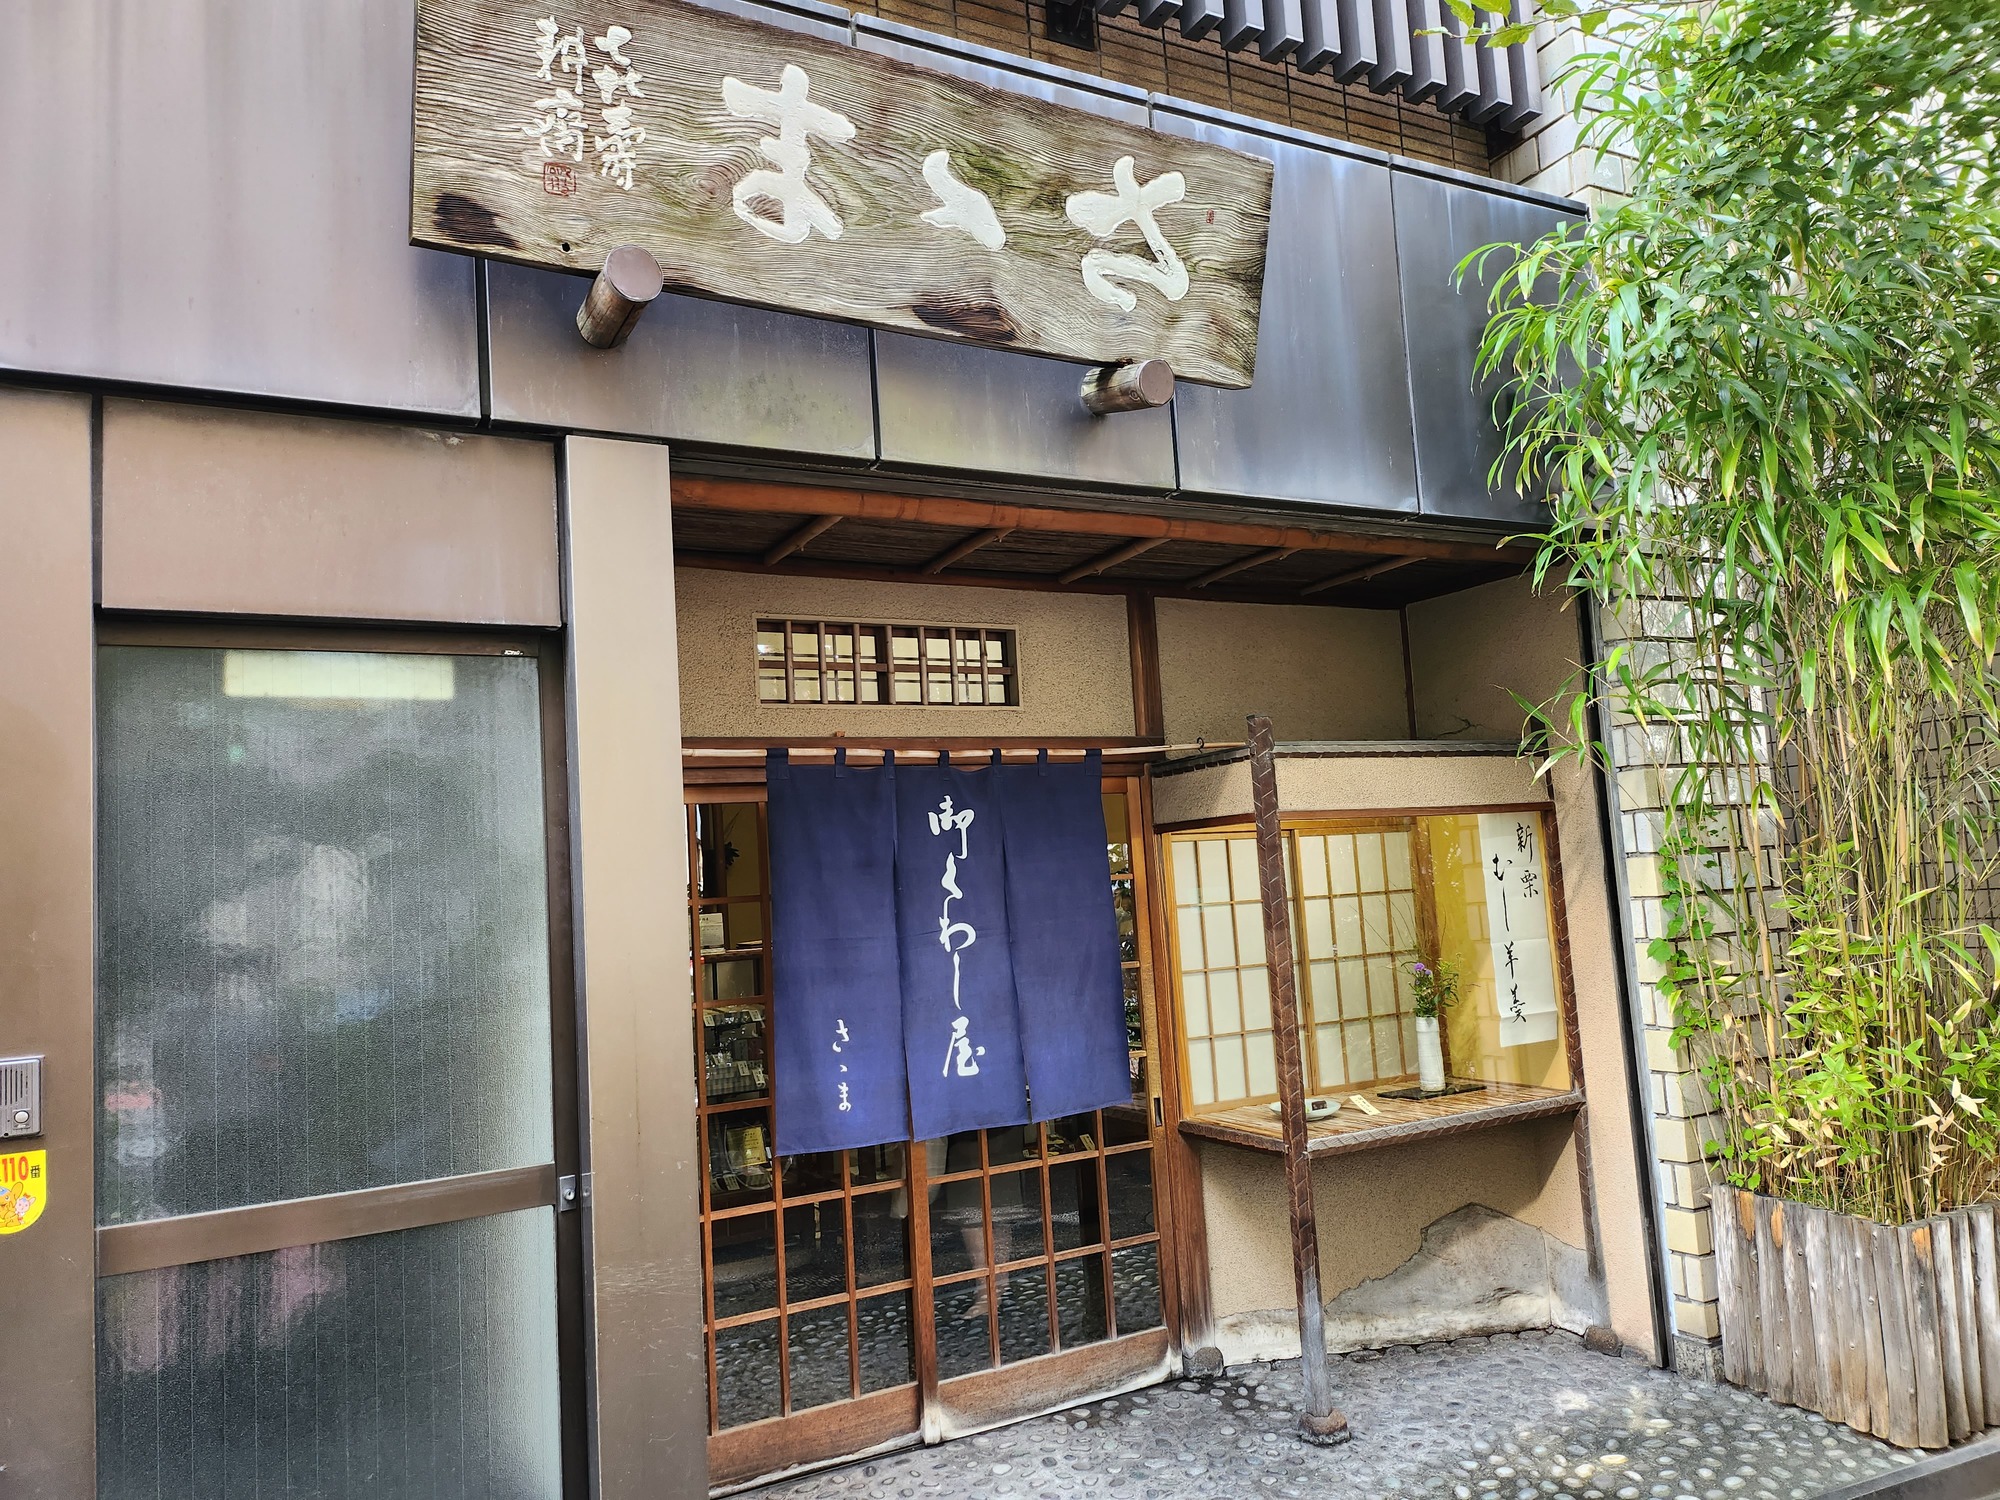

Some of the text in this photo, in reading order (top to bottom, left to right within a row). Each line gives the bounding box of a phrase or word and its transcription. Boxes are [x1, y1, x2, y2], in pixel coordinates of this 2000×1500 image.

[927, 795, 986, 1078] 御くわし屋
[1492, 853, 1527, 1024] むし羊羹
[1515, 822, 1539, 899] 新栗
